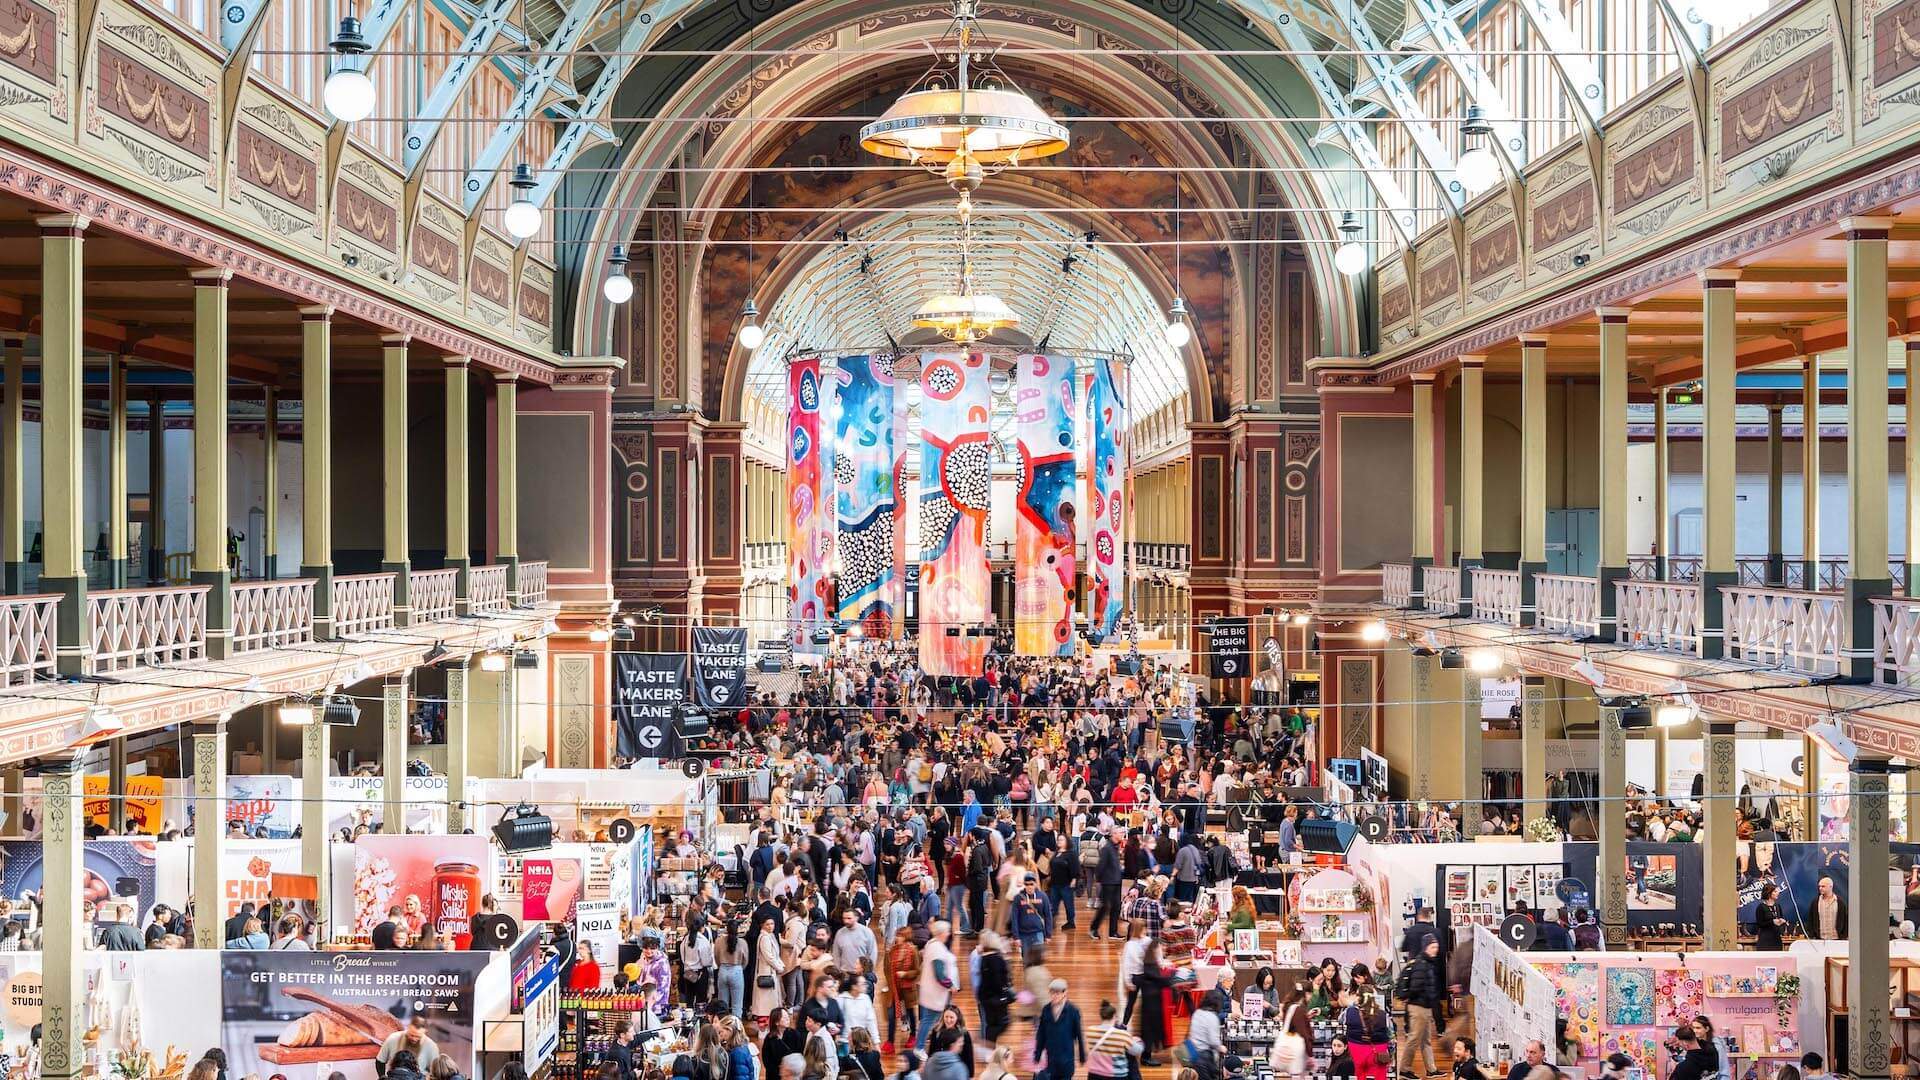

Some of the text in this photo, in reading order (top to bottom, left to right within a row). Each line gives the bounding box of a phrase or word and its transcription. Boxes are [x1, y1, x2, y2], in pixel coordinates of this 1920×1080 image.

[1212, 638, 1246, 646] DESIGN
[701, 643, 740, 653] TASTE
[1219, 648, 1239, 656] BAR
[1264, 640, 1281, 664] PIES
[696, 656, 745, 667] MAKERS
[627, 671, 676, 683] TASTE
[704, 670, 736, 680] LANE
[619, 688, 683, 700] MAKERS
[1496, 689, 1516, 697] ROSE
[631, 706, 672, 718] LANE
[689, 763, 697, 774] E
[348, 778, 383, 789] JIMO
[616, 824, 628, 838] D
[1369, 822, 1380, 836] D
[578, 901, 617, 911] SCAN TO WIN!
[495, 922, 508, 940] C
[1510, 923, 1525, 940] C
[332, 954, 371, 972] Bread
[250, 972, 459, 986] GET BETTER IN THE BREADROOM
[12, 984, 43, 995] BIG BIT
[331, 988, 388, 997] AUSTRALIA'S
[402, 989, 433, 997] BREAD
[434, 989, 459, 998] SAWS
[11, 996, 43, 1007] STUDIO
